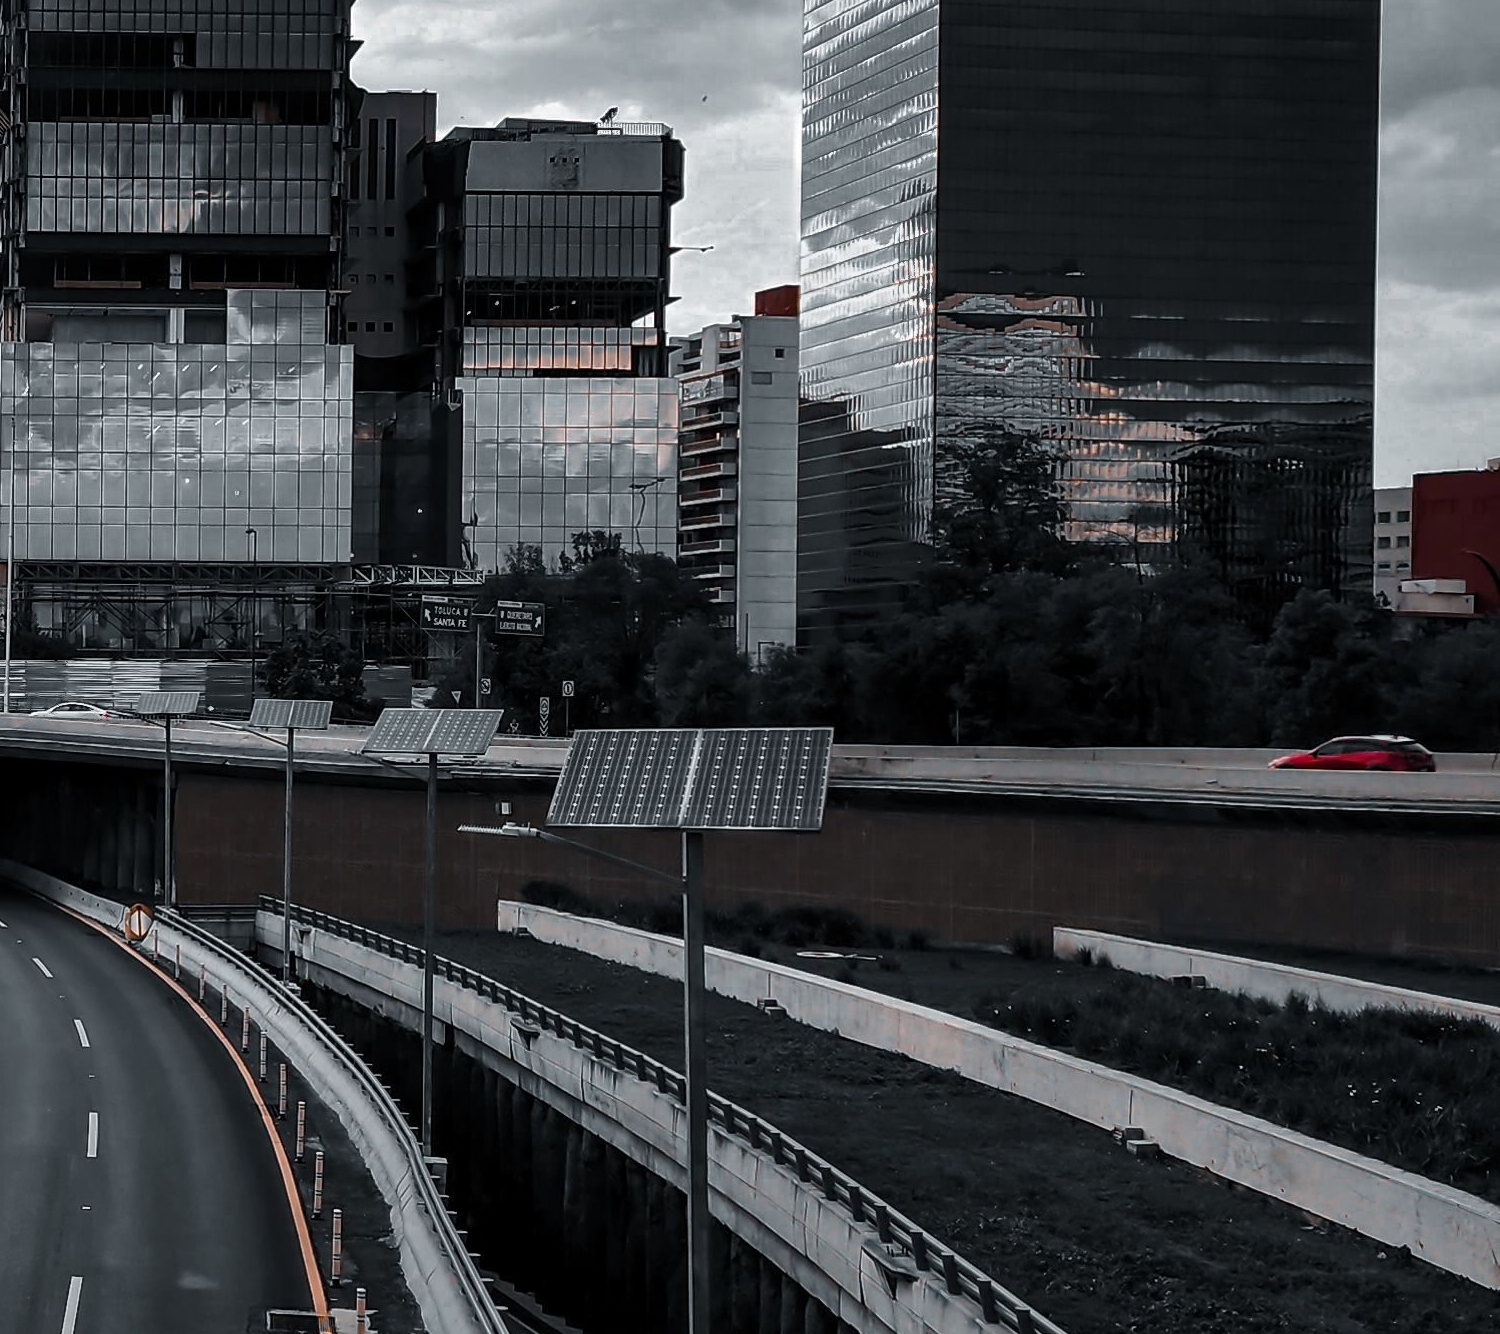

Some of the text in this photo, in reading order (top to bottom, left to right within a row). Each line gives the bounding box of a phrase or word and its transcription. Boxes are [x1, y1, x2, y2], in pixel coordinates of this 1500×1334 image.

[434, 605, 461, 616] TOLUCA
[433, 617, 468, 628] SANTA FE
